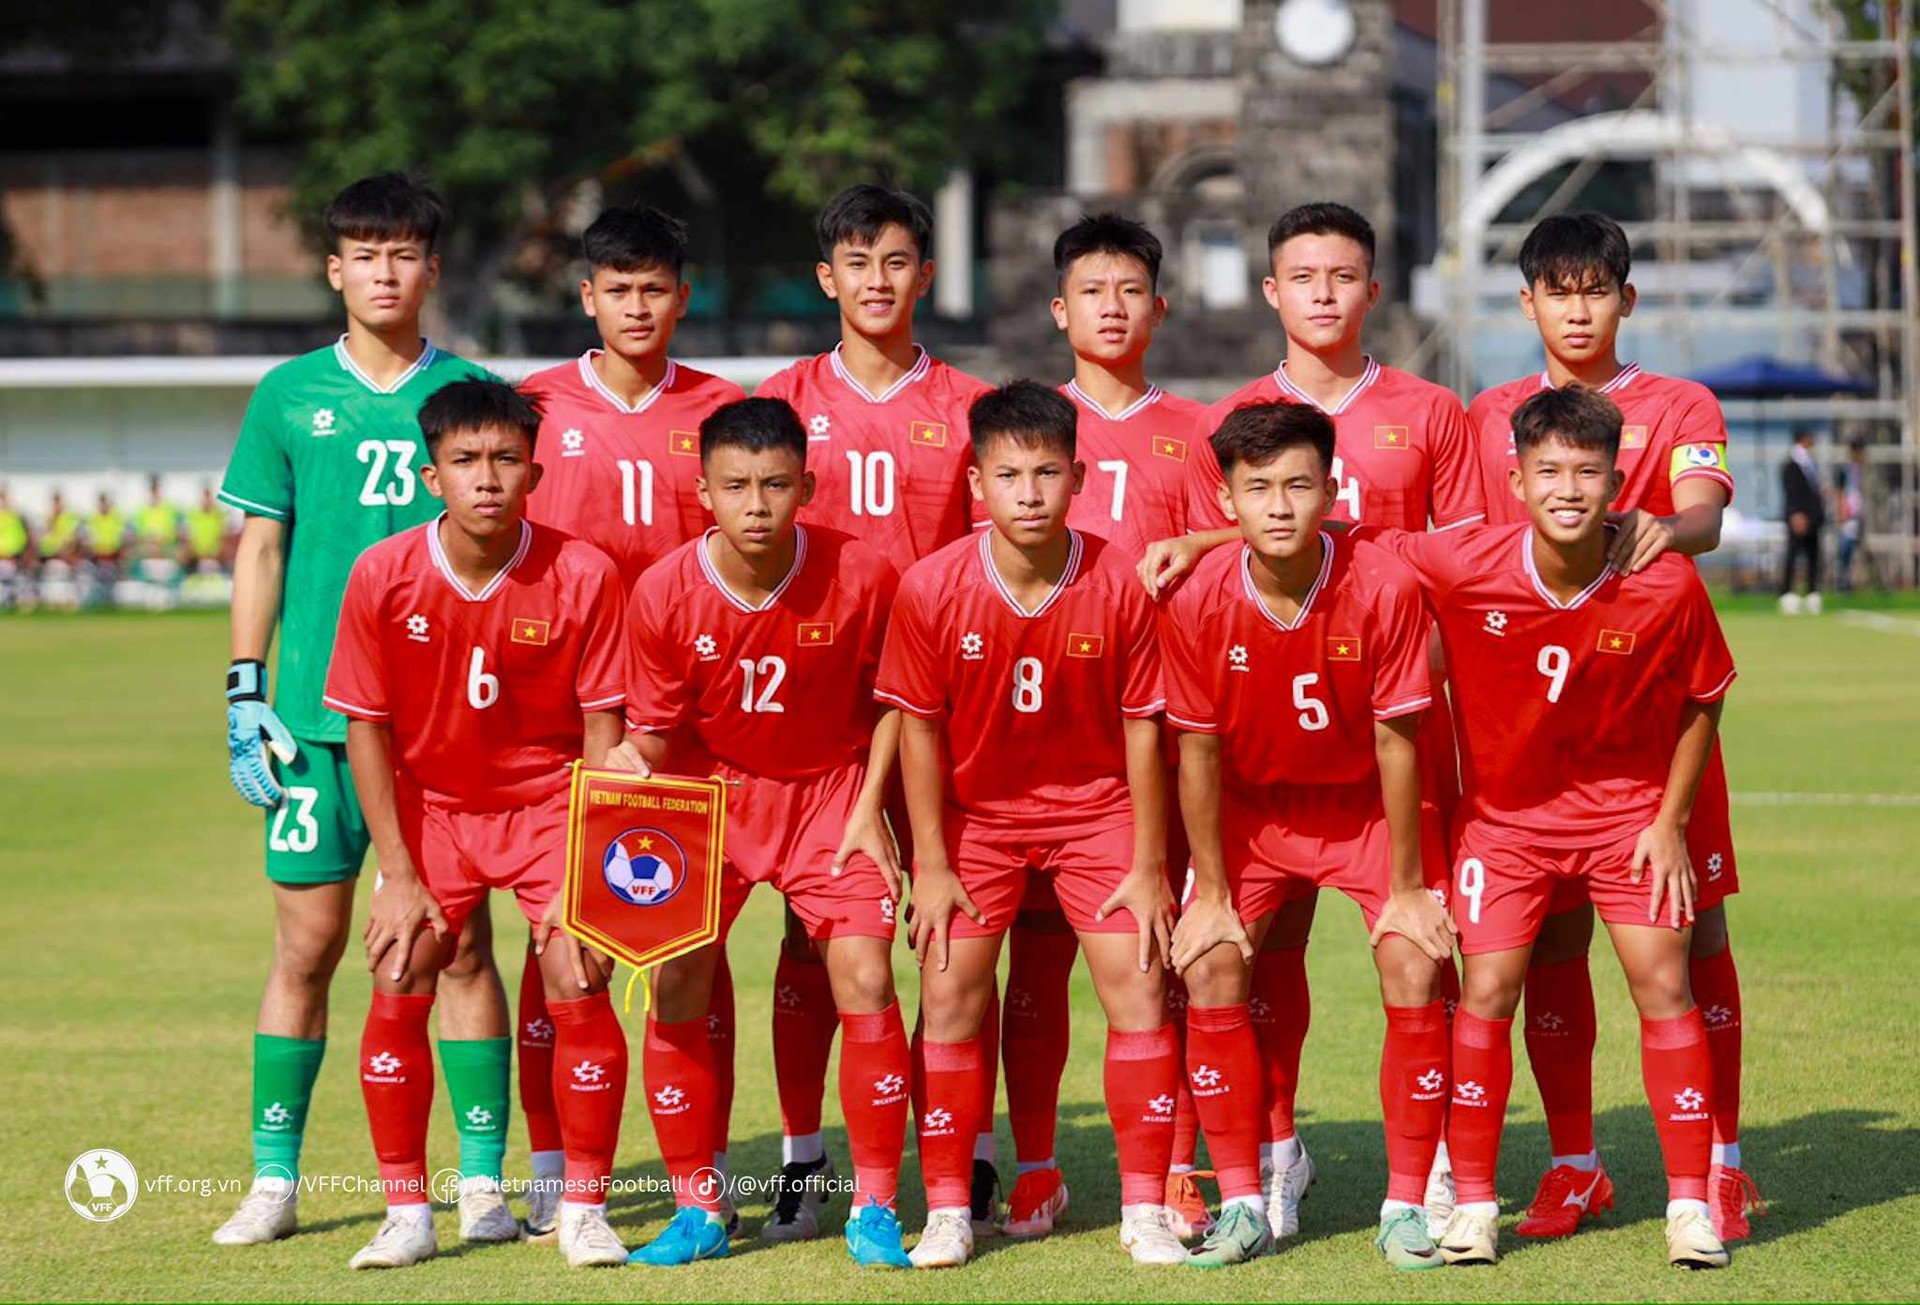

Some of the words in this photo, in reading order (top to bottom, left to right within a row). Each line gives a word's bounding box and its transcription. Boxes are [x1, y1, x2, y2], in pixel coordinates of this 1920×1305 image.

[357, 440, 417, 506] 23
[617, 459, 654, 526] 11
[846, 450, 895, 517] 10
[1097, 459, 1129, 522] 7
[1330, 455, 1361, 520] 4
[467, 646, 499, 709] 6
[739, 655, 785, 713] 12
[1013, 656, 1043, 713] 8
[1292, 672, 1330, 731] 5
[1537, 645, 1570, 703] 9
[269, 786, 319, 853] 23
[623, 793, 661, 809] FOOTBALL
[662, 796, 708, 814] FEDERATION
[631, 884, 656, 896] VFF
[1459, 857, 1486, 924] 9
